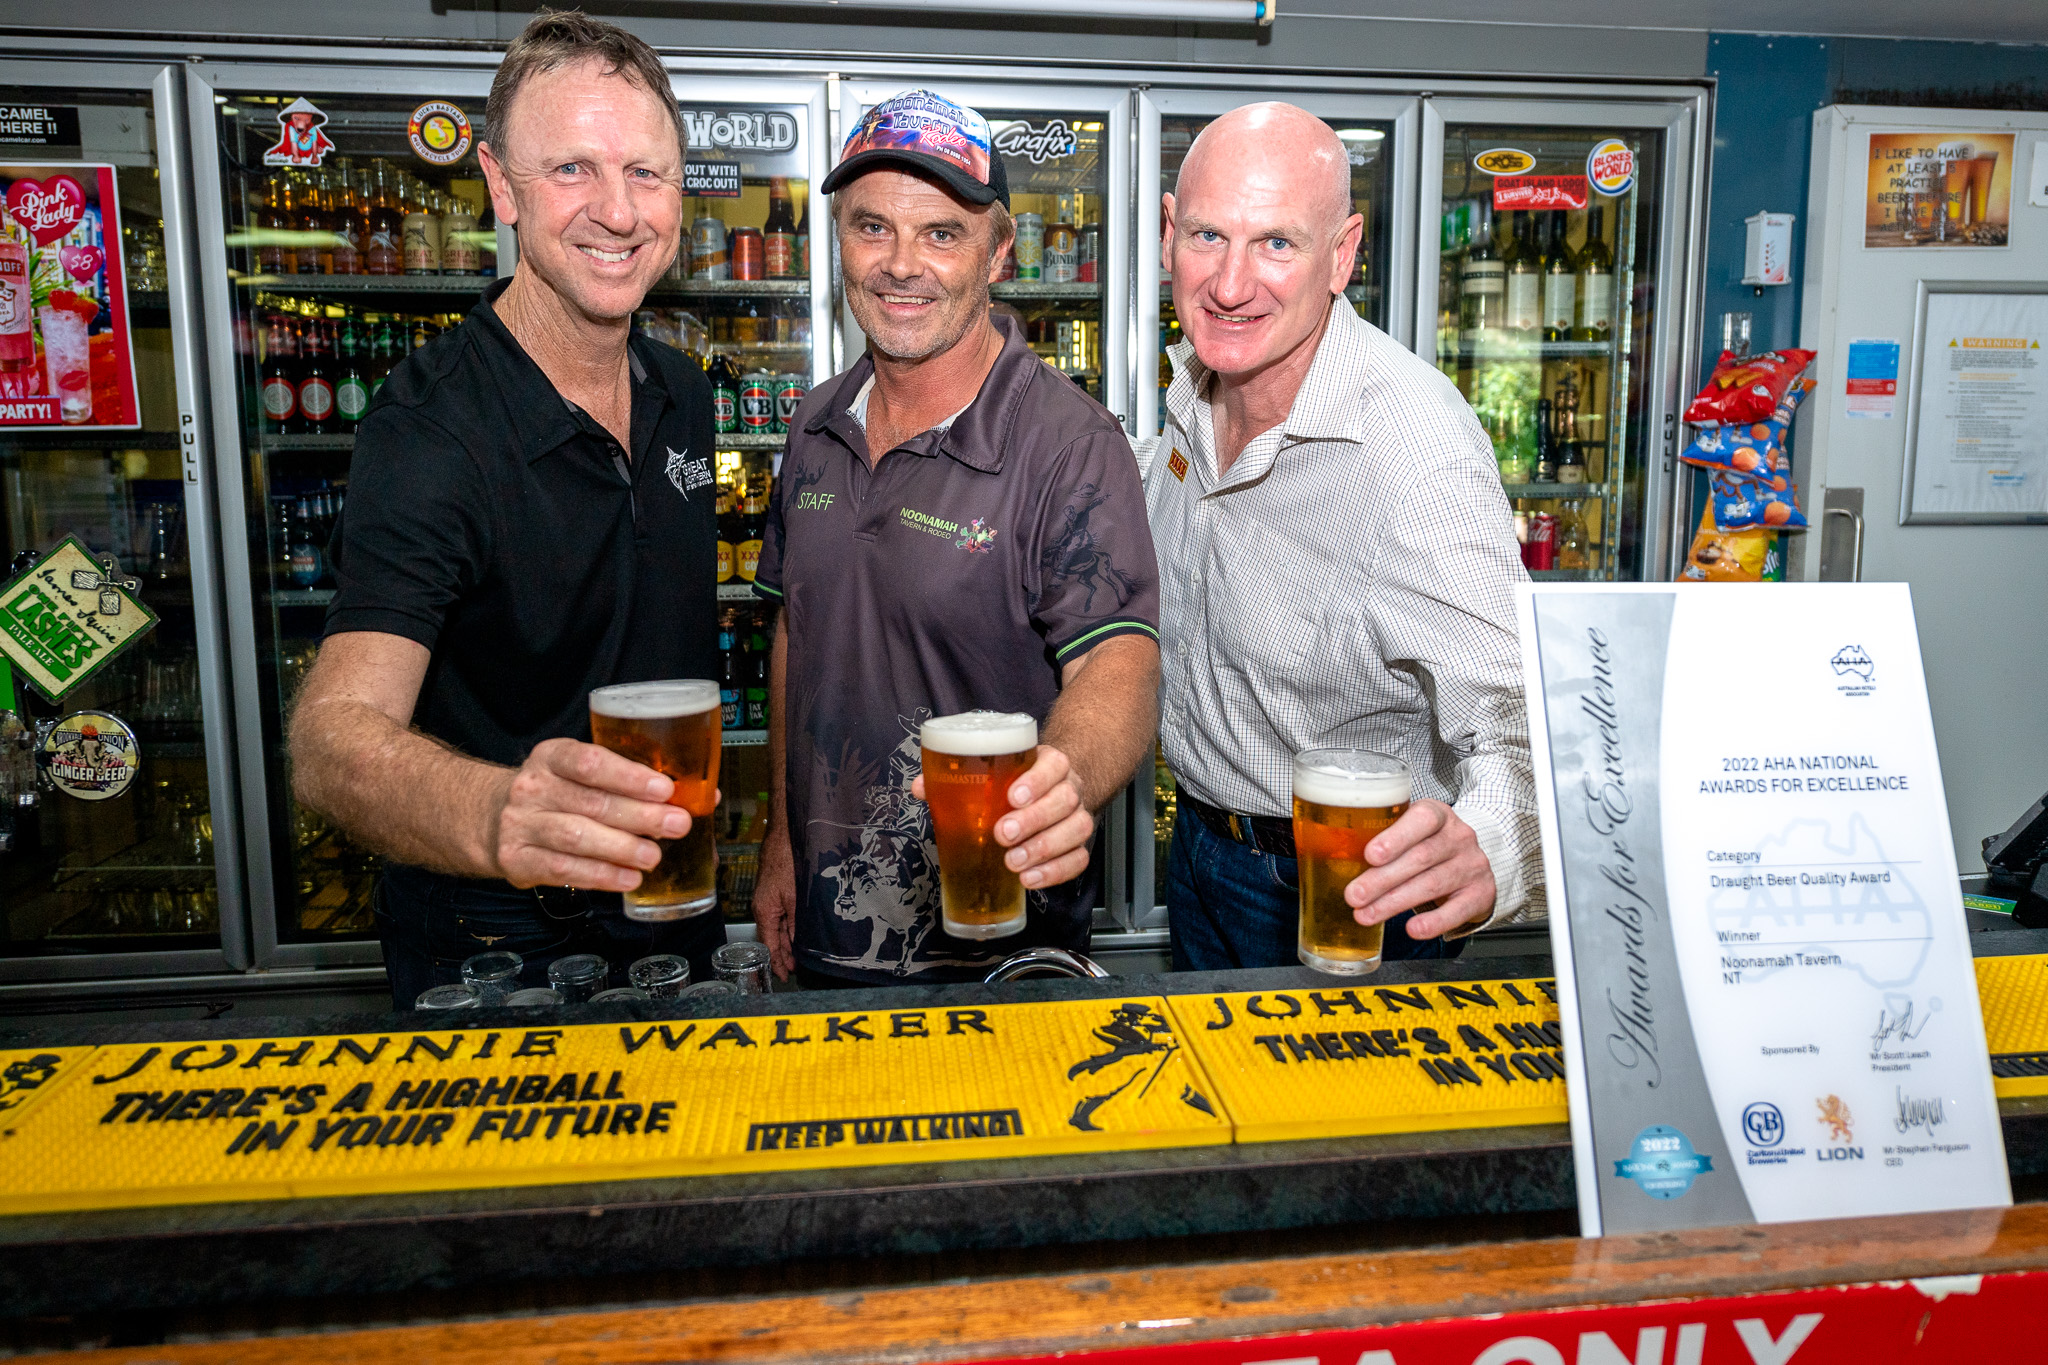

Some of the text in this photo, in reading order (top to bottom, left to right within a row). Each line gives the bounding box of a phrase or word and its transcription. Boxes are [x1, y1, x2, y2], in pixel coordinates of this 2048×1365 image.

[0, 108, 54, 121] CAMEL
[416, 104, 434, 120] LUCKY
[1, 121, 43, 134] HERE
[682, 112, 796, 150] WORLD
[894, 112, 950, 134] Tavern
[919, 126, 968, 148] Rodeo
[995, 125, 1073, 159] Grafix
[1594, 151, 1632, 167] BLOKES
[1886, 148, 1912, 160] LIKE
[1918, 148, 1934, 160] TO
[1939, 148, 1969, 160] HAVE
[709, 165, 738, 177] WITH
[1594, 161, 1632, 181] WORLD
[1887, 163, 1903, 174] AT
[1907, 162, 1944, 174] LEAST
[686, 177, 738, 190] CROC OUT!
[1890, 177, 1947, 189] PRACTICE
[10, 183, 68, 218] Pink
[1877, 192, 1961, 204] BEERS BEFORE
[30, 202, 82, 232] Lady
[1896, 207, 1927, 219] HAVE
[71, 254, 93, 271] $8
[1967, 339, 2024, 348] WARNING
[0, 404, 52, 419] PARTY!
[742, 398, 771, 415] VB
[182, 415, 197, 482] PULL
[1664, 413, 1674, 473] PULL
[681, 458, 709, 477] GREAT
[797, 492, 836, 511] STAFF
[900, 507, 959, 534] NOONAMAH
[900, 517, 923, 532] TAVERN
[927, 526, 952, 540] RODEO
[293, 563, 315, 572] NEW
[37, 569, 78, 607] James
[28, 584, 59, 613] ONE
[6, 590, 93, 669] LASHES
[58, 611, 103, 651] FIFTY
[78, 607, 116, 644] Squire
[8, 624, 55, 667] PALE ALE
[750, 711, 764, 720] YAK
[98, 734, 125, 752] UNION
[51, 762, 95, 782] GINGER
[1722, 755, 1879, 772] 2022 AHA NATIONAL
[1699, 776, 1910, 794] AWARDS FOR EXCELLENCE
[1581, 627, 1660, 1088] Awards for Excellence
[1706, 849, 1762, 864] Category
[1710, 870, 1891, 890] Draught Beer Quality Award
[1716, 930, 1762, 944] Winner
[1721, 952, 1842, 970] Noonamah Tavern
[1723, 971, 1743, 985] NT
[618, 1009, 997, 1055] WALKER
[1254, 1026, 1452, 1064] THERE'S
[1457, 1024, 1498, 1053] A
[1808, 1044, 1820, 1056] By
[93, 1028, 565, 1086] JOHNNIE
[1417, 1056, 1484, 1087] IN
[1871, 1063, 1911, 1073] President
[99, 1068, 626, 1126] THERE'S A HIGHBALL
[224, 1100, 678, 1157] IN YOUR FUTURE
[760, 1114, 1013, 1149] KEEP WALKING
[1640, 1136, 1682, 1152] 2022
[1817, 1147, 1865, 1162] LION
